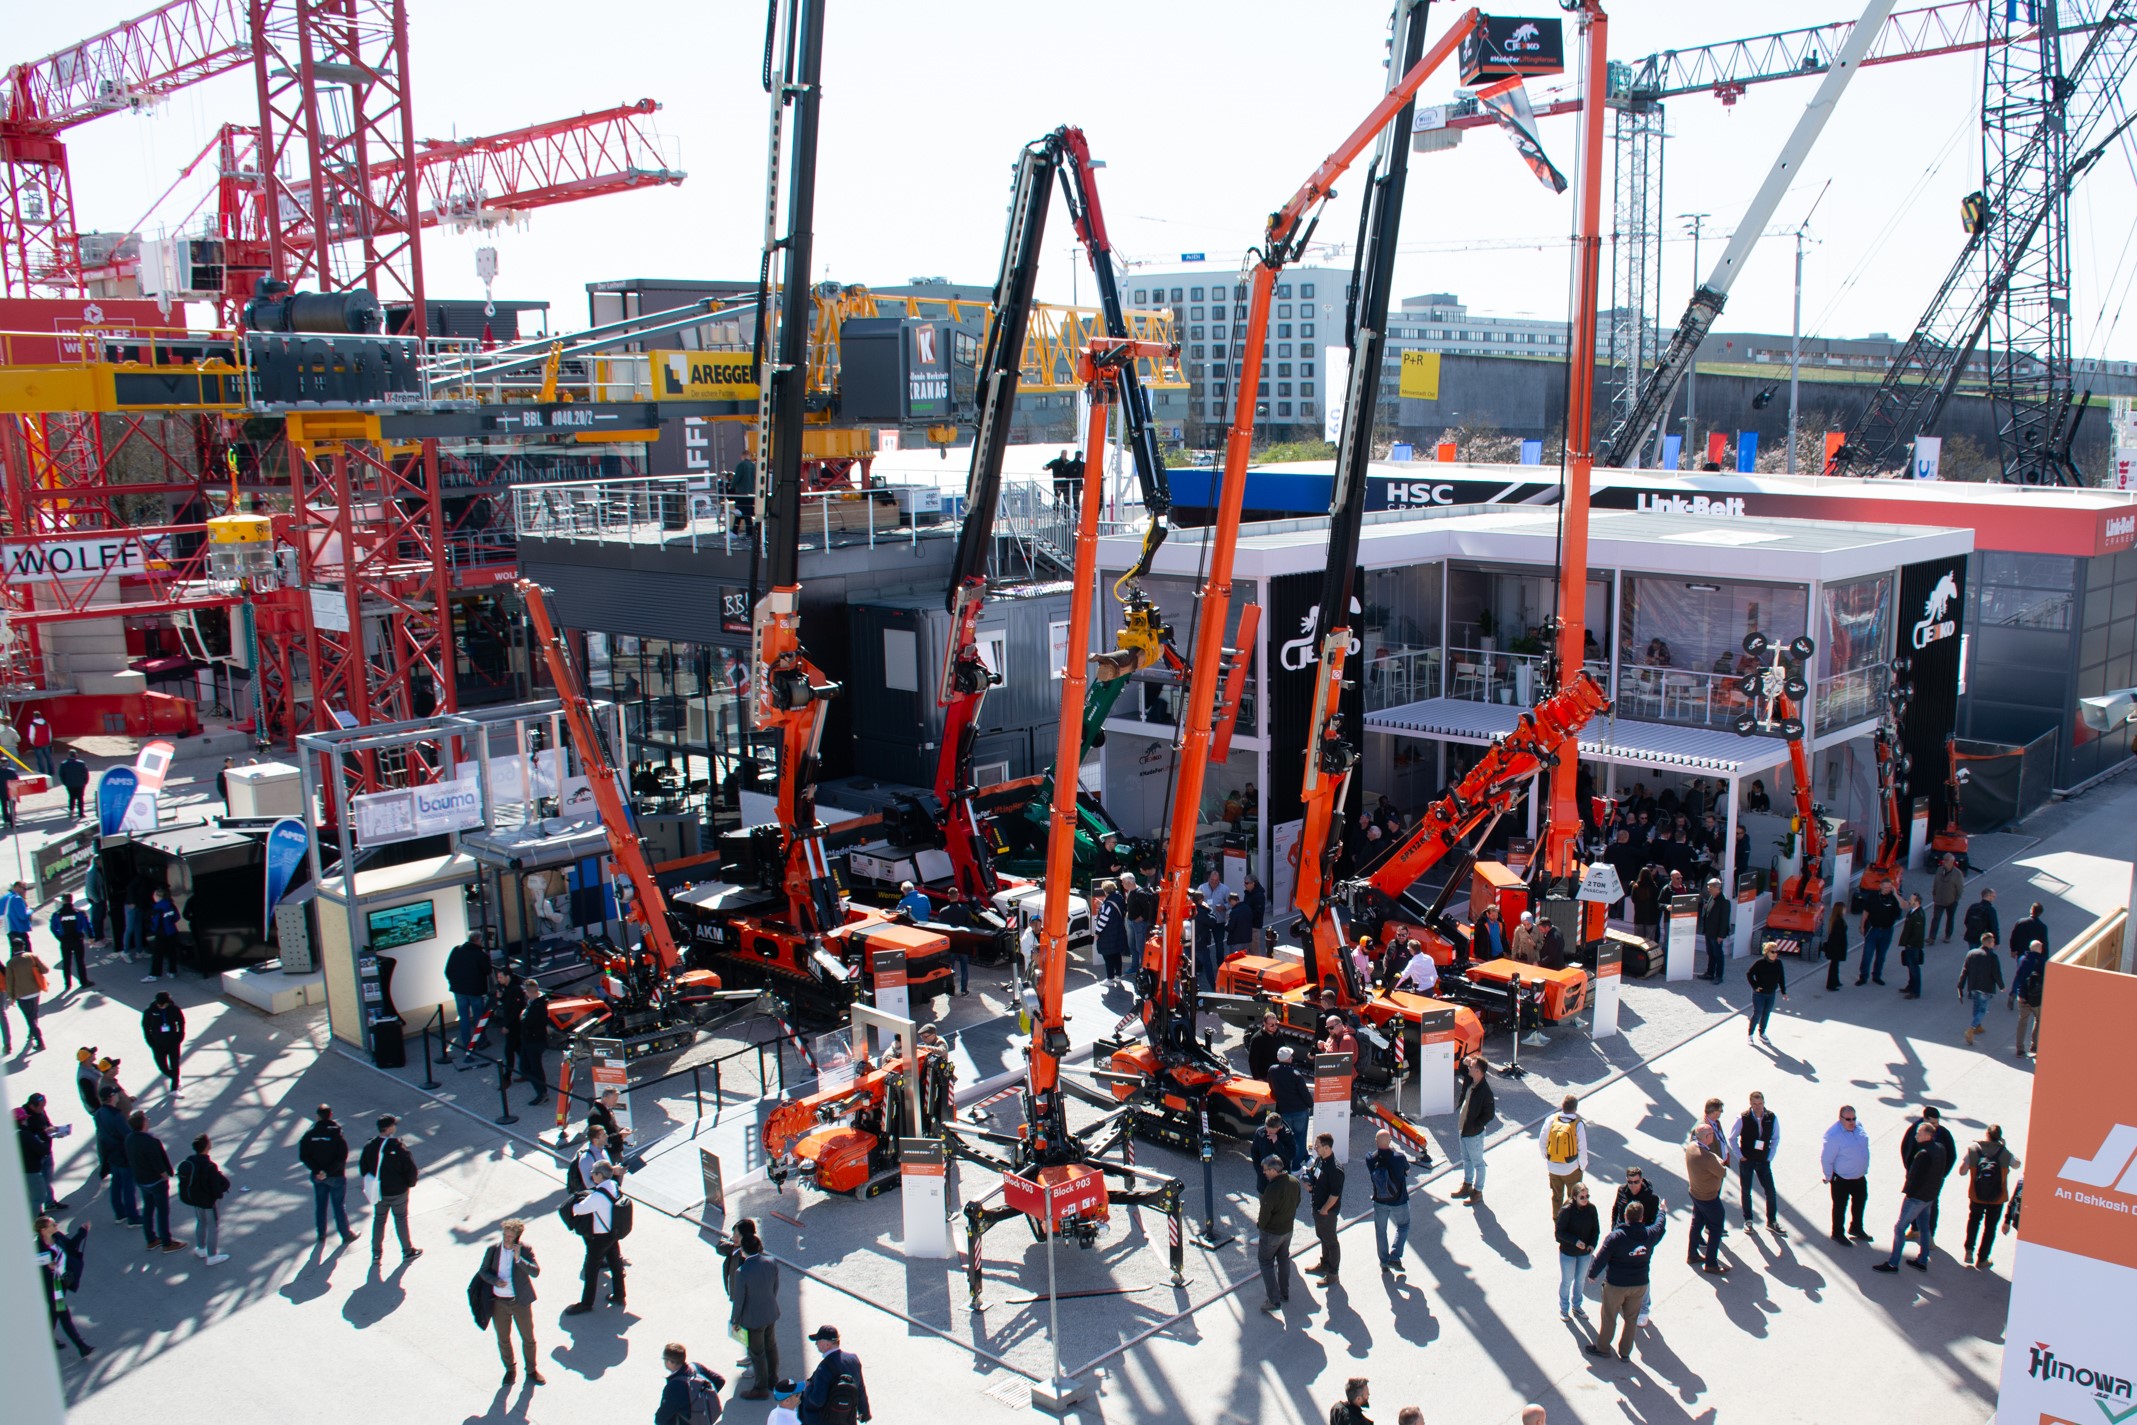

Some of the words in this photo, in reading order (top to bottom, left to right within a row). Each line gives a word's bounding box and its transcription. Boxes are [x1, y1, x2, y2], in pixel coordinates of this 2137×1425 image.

[1403, 353, 1424, 366] P+R
[691, 364, 755, 385] AREGGE
[387, 393, 421, 404] X-treme
[935, 381, 948, 400] AG
[523, 411, 543, 427] BBL
[1387, 482, 1454, 505] HSC
[1637, 493, 1746, 516] Link-Belt
[2106, 515, 2135, 537] Link-Belt
[13, 543, 138, 576] WOLFF
[106, 777, 134, 786] AMS
[418, 793, 476, 813] bauma
[696, 924, 724, 941] AKM
[1004, 1174, 1021, 1189] Block
[1022, 1182, 1034, 1195] 903
[1053, 1185, 1074, 1198] Block
[1075, 1177, 1091, 1190] 903
[2055, 1187, 2072, 1200] An
[2075, 1192, 2129, 1213] Oshkosh
[2094, 1391, 2110, 1400] JLG
